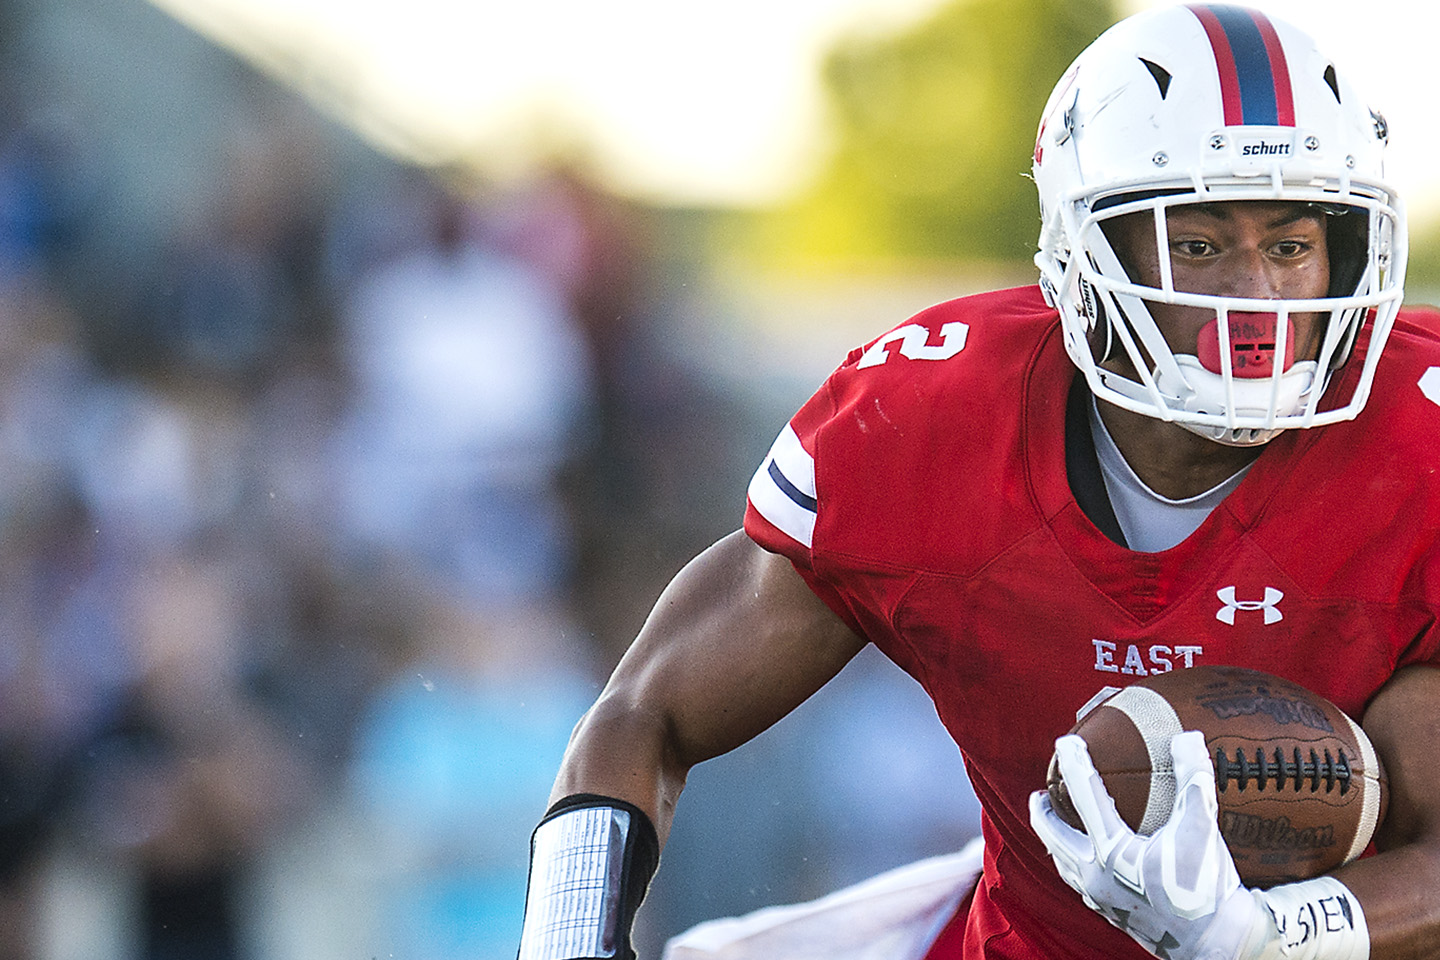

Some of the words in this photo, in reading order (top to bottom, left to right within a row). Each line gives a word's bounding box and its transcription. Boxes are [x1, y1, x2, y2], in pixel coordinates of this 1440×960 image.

[1242, 140, 1290, 155] schutt
[856, 321, 969, 370] 2
[1091, 638, 1203, 677] EAST
